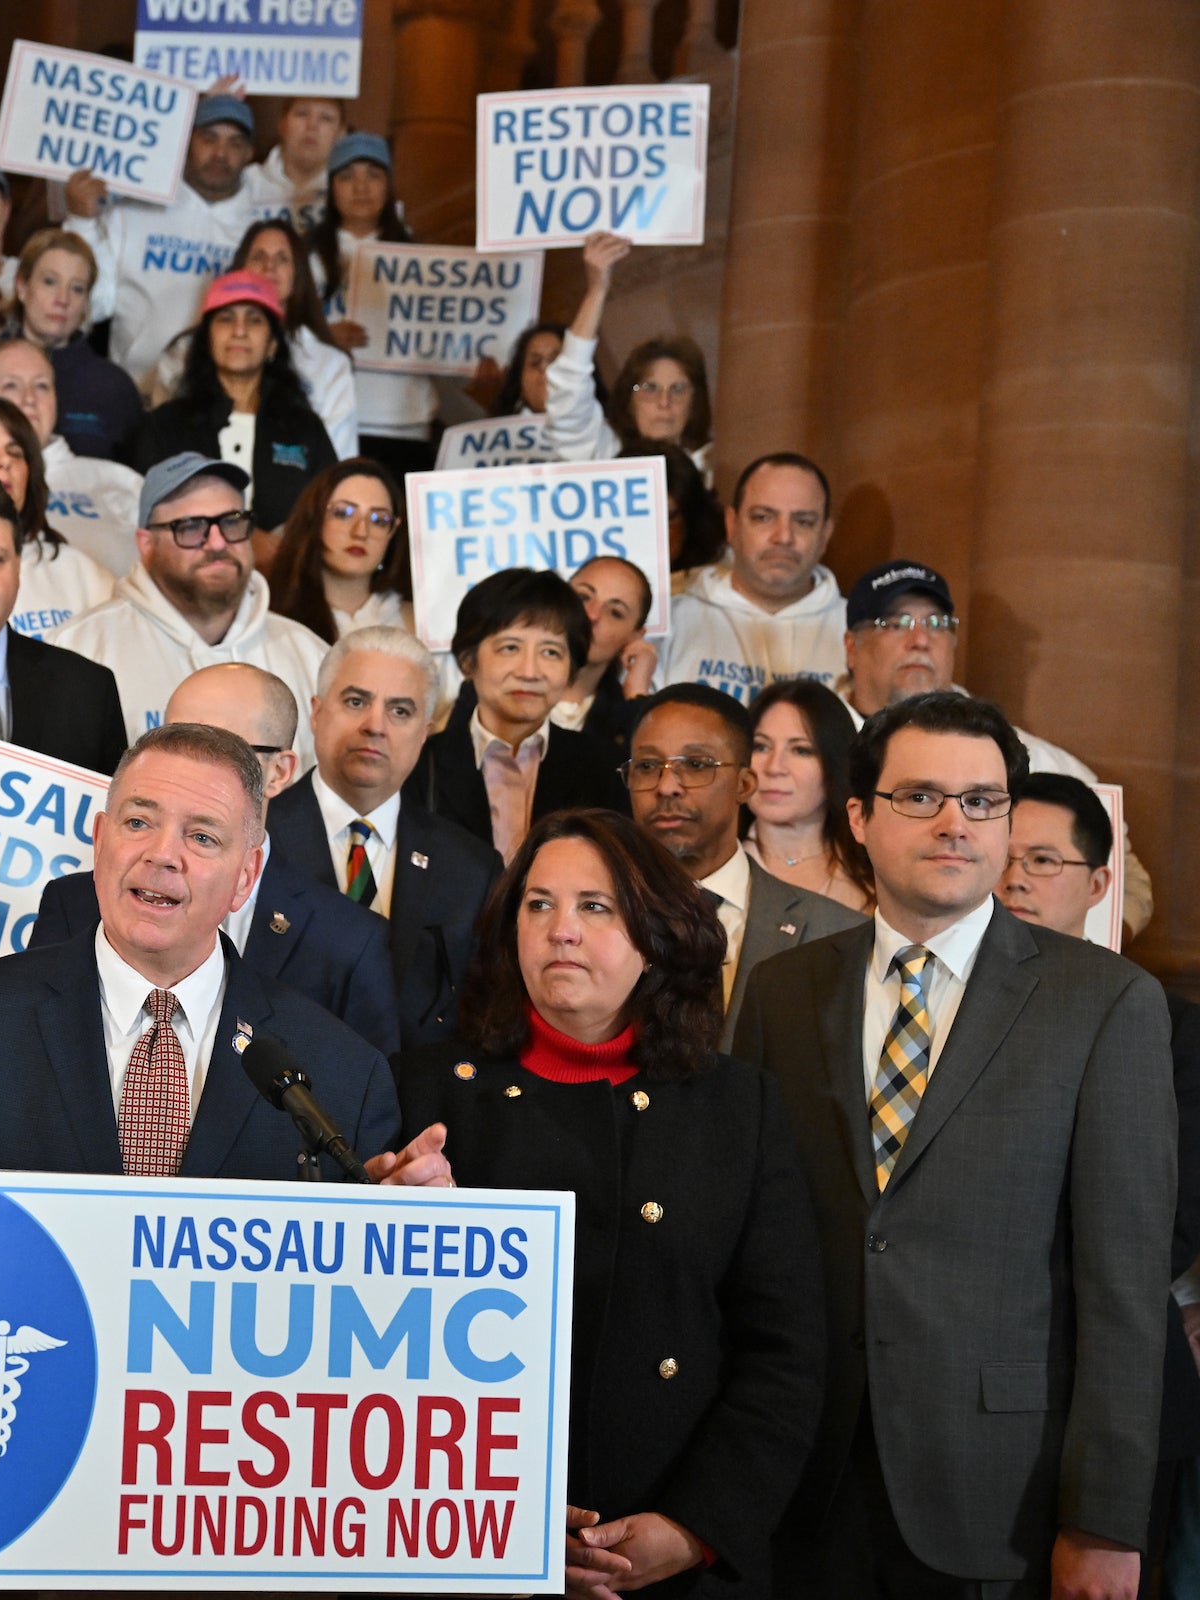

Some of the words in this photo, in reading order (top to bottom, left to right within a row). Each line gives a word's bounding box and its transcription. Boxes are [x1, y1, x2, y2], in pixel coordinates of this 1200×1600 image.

[32, 57, 178, 115] NASSAU
[145, 45, 350, 85] #TEAMNUMC
[43, 96, 160, 148] NEEDS
[493, 102, 692, 145] RESTORE
[37, 133, 148, 184] NUMC
[514, 144, 667, 185] FUNDS
[514, 184, 669, 236] NOW
[143, 250, 223, 275] NUM
[374, 256, 522, 290] NASSAU
[388, 294, 508, 326] NEEDS
[386, 329, 498, 361] NUMC
[426, 477, 650, 530] RESTORE
[455, 526, 628, 576] FUNDS
[131, 1214, 345, 1273] NASSAU
[363, 1222, 529, 1280] NEEDS
[126, 1278, 528, 1383] NUMC
[121, 1388, 521, 1491] RESTORE
[117, 1494, 367, 1557] FUNDING
[386, 1497, 516, 1560] NOW
